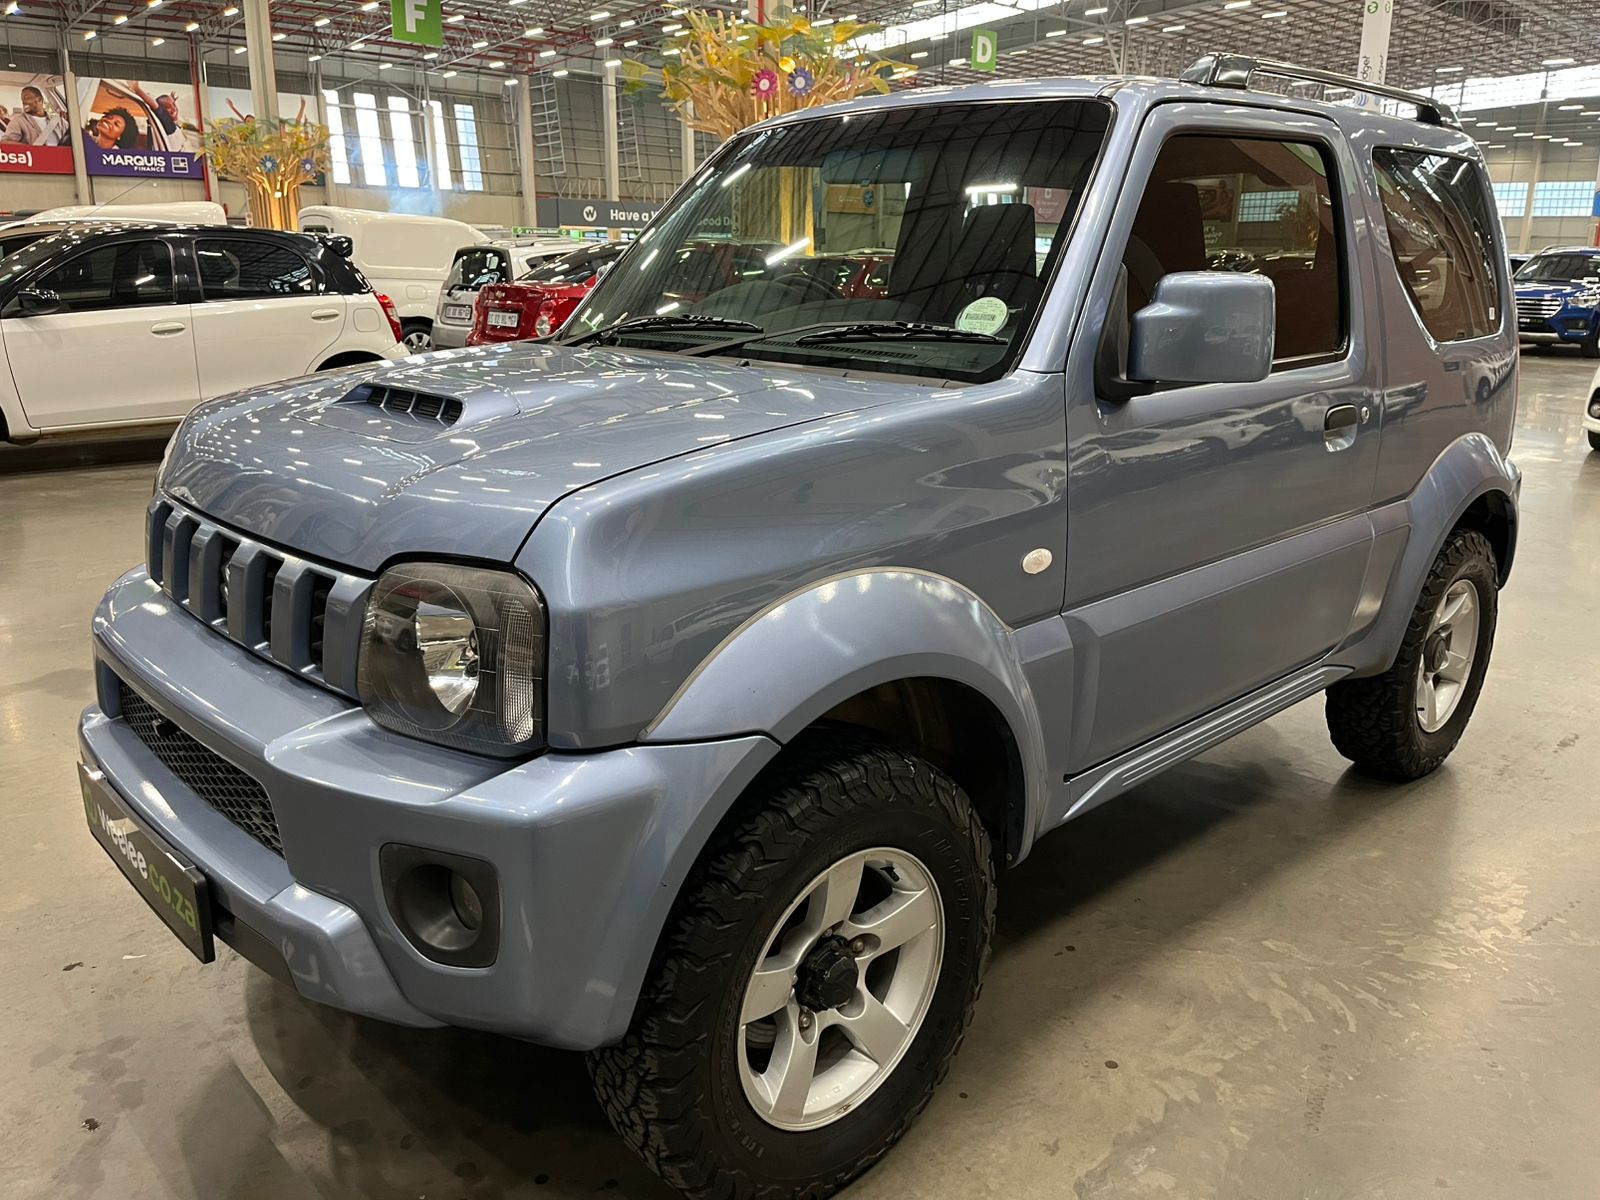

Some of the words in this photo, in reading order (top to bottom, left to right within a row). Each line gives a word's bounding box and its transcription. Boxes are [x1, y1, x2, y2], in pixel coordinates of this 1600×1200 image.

[405, 0, 428, 33] F
[976, 35, 992, 63] D
[1361, 55, 1372, 79] dget
[102, 154, 166, 167] MARQUIS
[610, 209, 640, 221] Have
[641, 212, 649, 221] a
